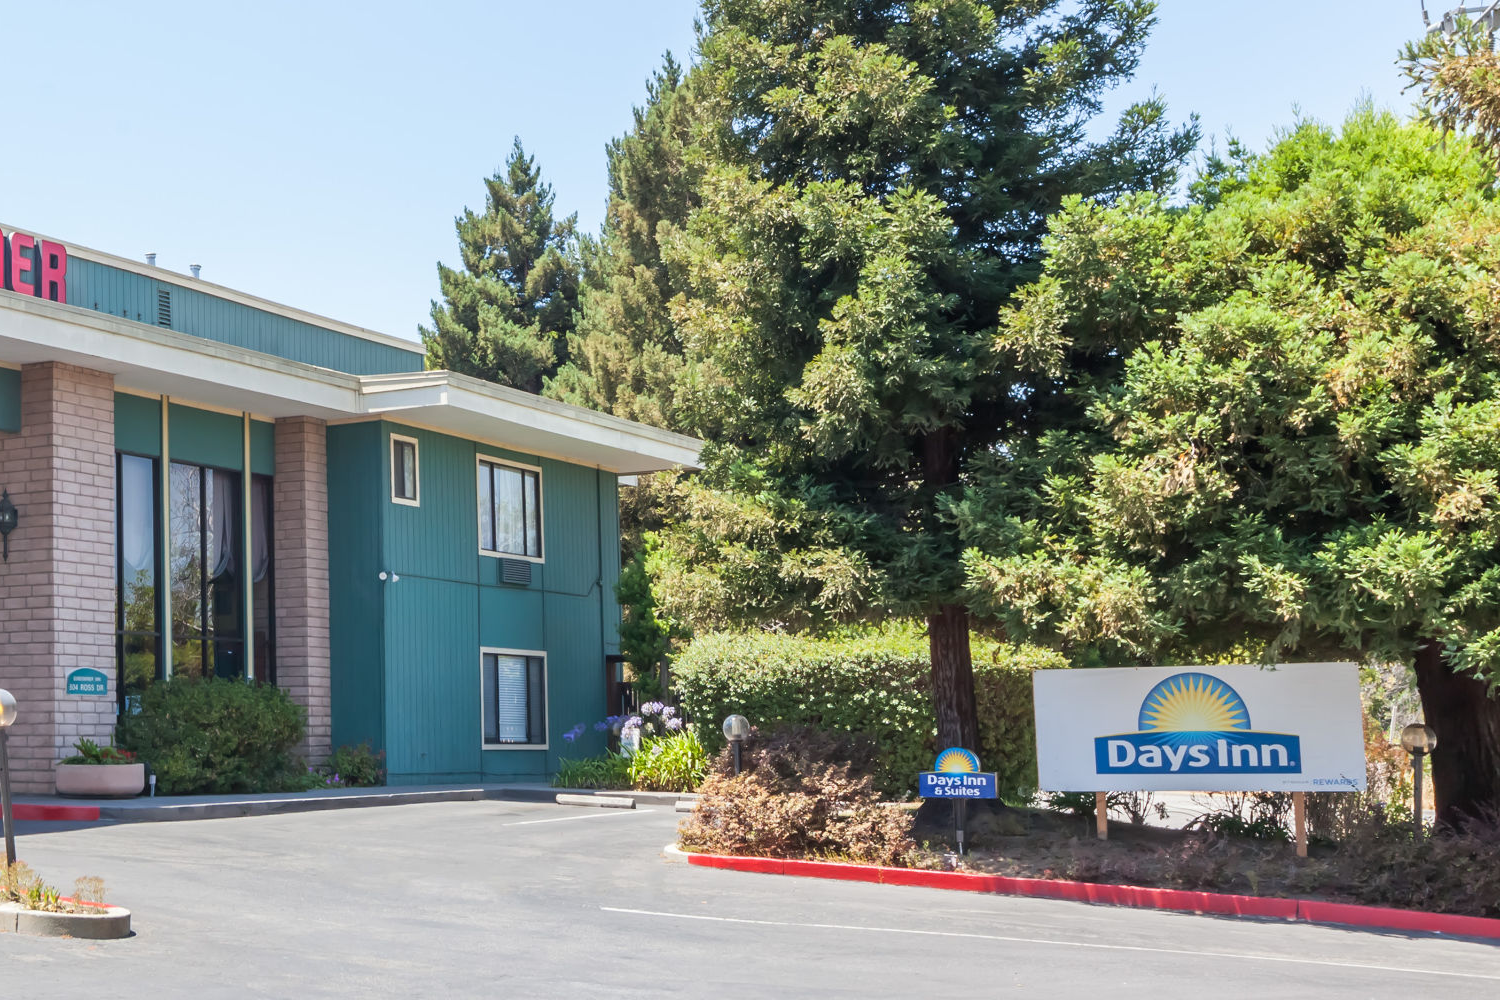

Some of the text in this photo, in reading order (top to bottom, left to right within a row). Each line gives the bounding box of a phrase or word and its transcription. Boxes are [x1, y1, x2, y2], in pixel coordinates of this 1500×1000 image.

[80, 683, 94, 691] ROSS
[1107, 739, 1288, 771] Days Inn
[927, 774, 986, 786] Days Inn
[1313, 778, 1358, 786] REWARDS
[934, 786, 980, 796] & Suites
